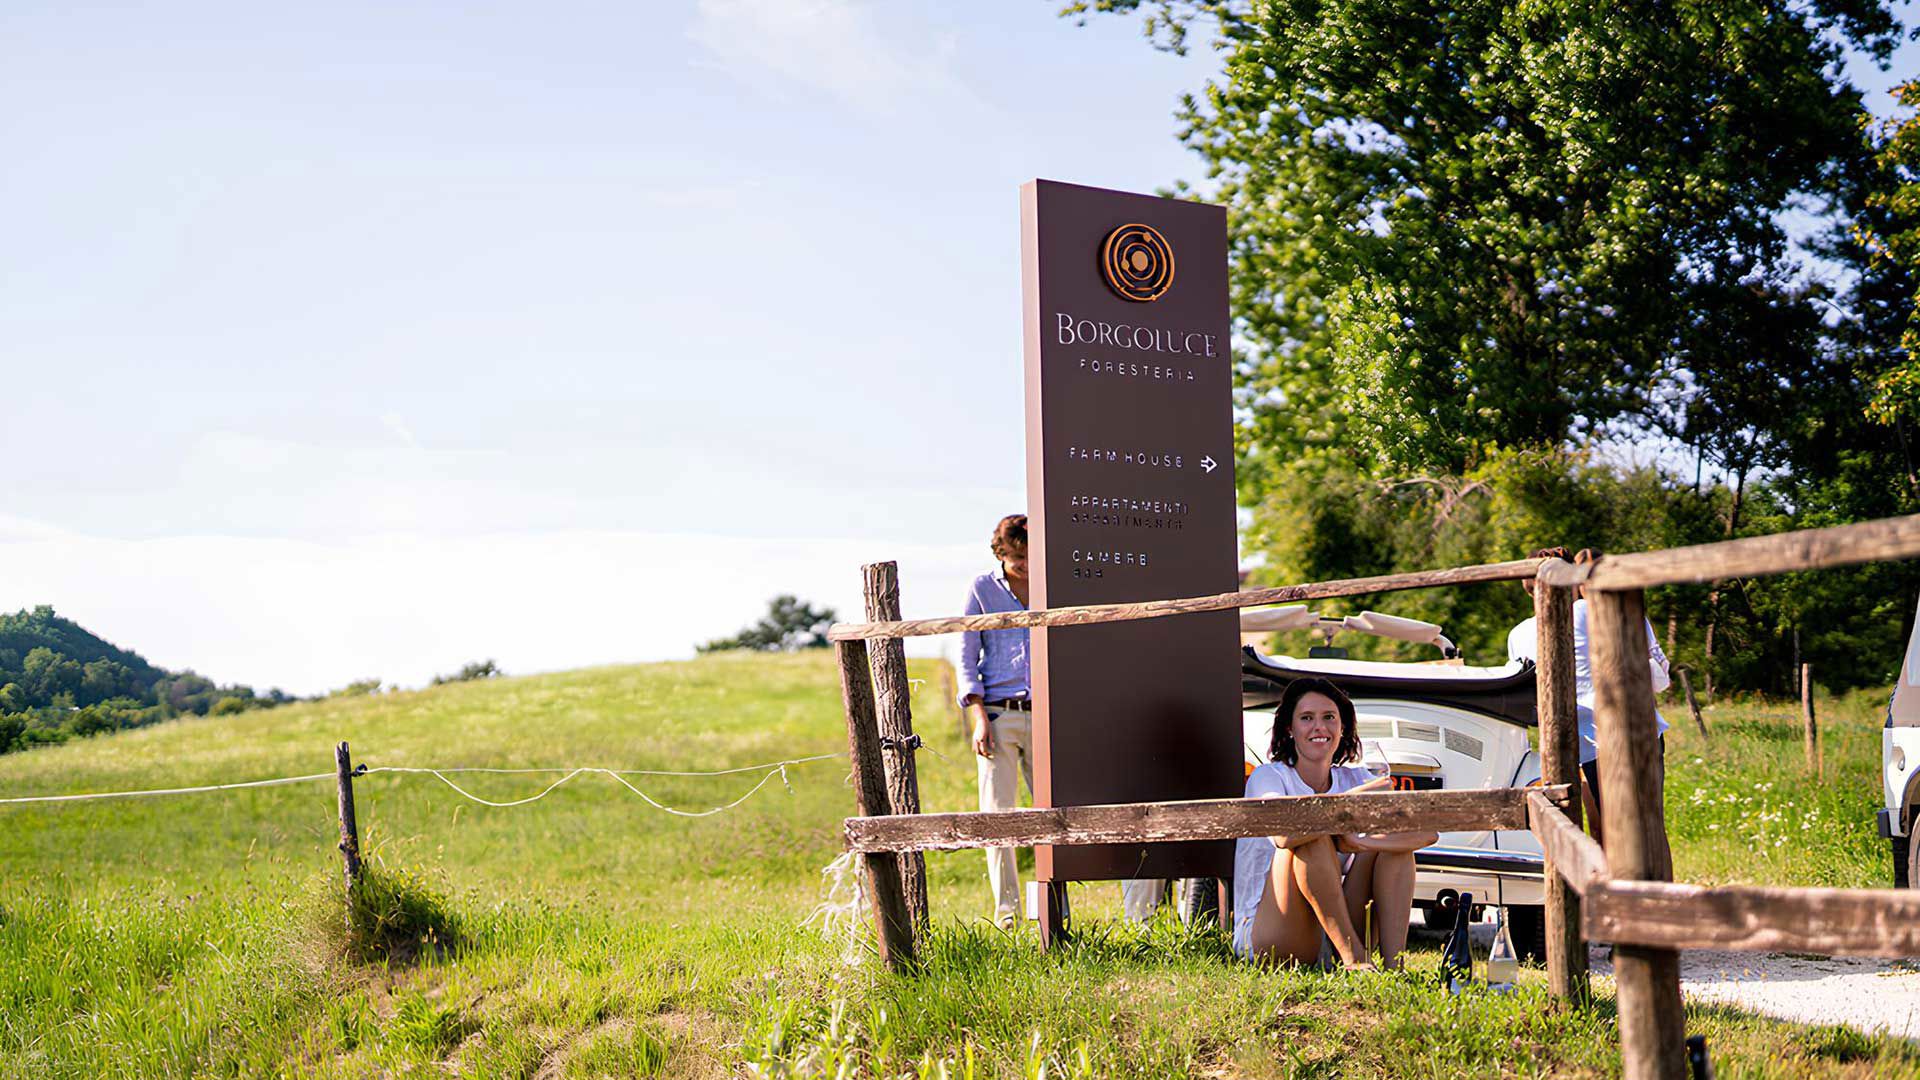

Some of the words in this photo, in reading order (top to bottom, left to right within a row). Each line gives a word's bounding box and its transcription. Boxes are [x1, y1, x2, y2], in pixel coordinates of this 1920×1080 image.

[1056, 313, 1217, 357] BORGOLUCE
[1080, 359, 1194, 381] FORESTERIA
[1071, 496, 1189, 515] APPARTAMENTI
